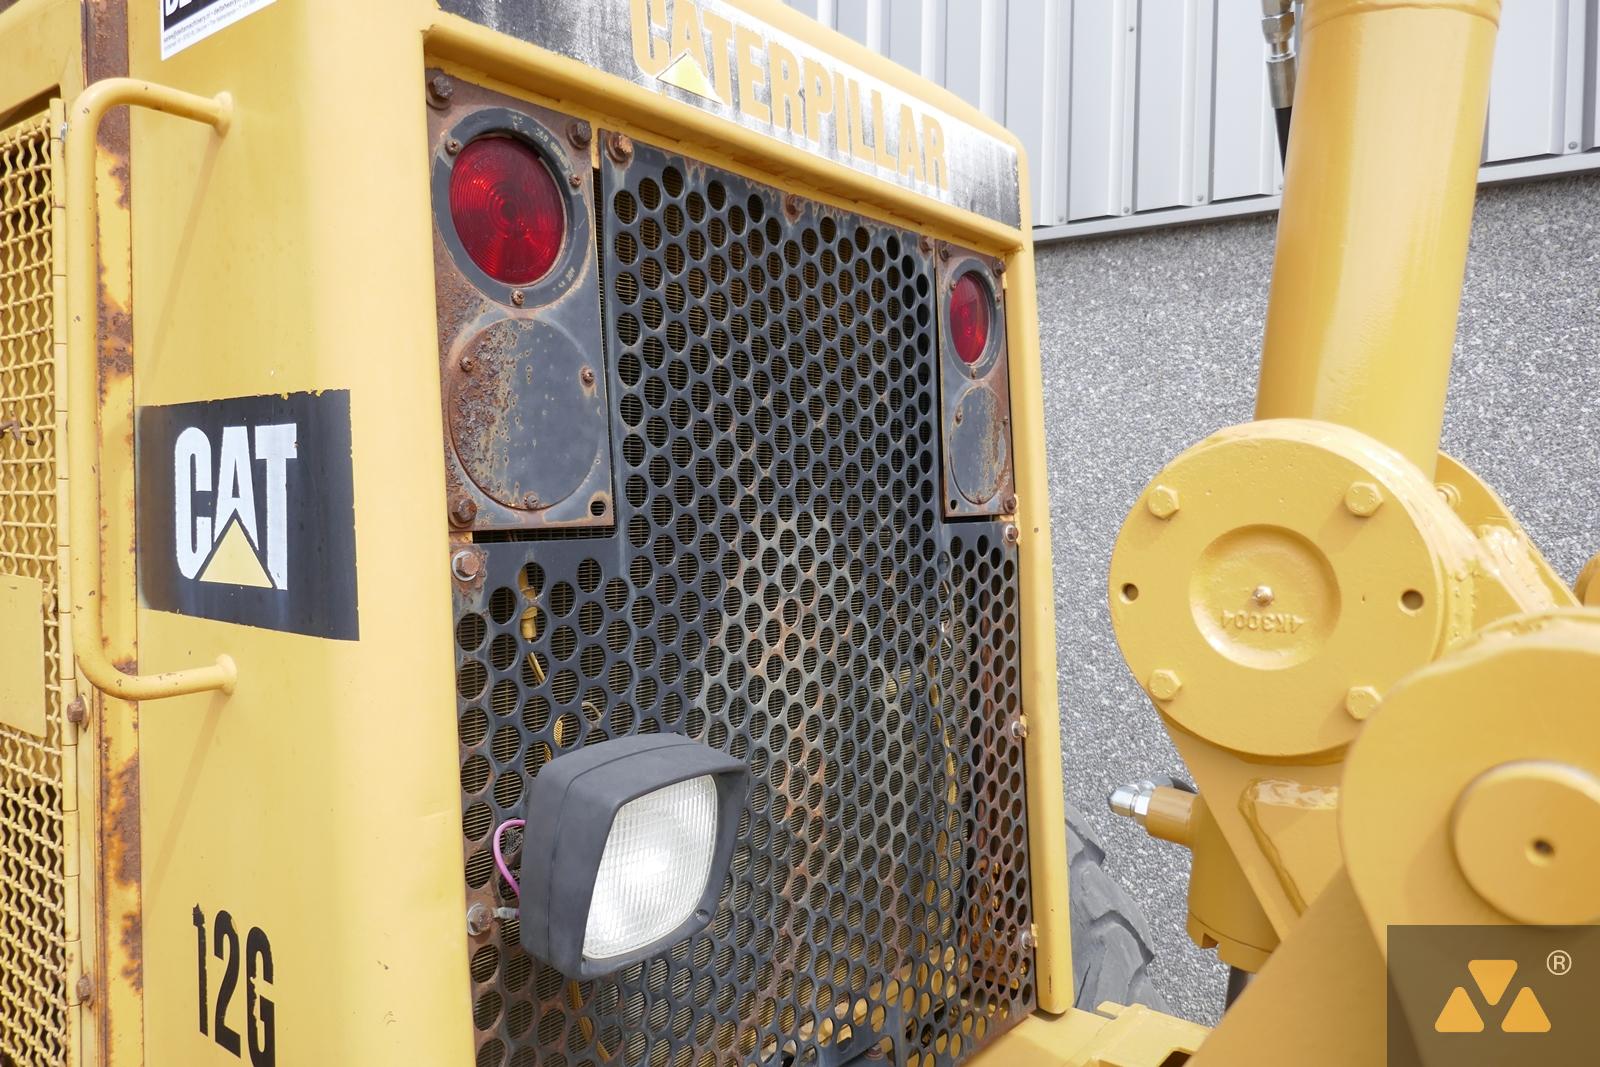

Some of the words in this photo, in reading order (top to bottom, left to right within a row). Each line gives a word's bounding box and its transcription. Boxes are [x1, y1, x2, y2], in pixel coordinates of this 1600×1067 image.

[631, 0, 950, 192] CATERPILLAR
[174, 422, 298, 590] CAT
[192, 902, 276, 1067] 12G
